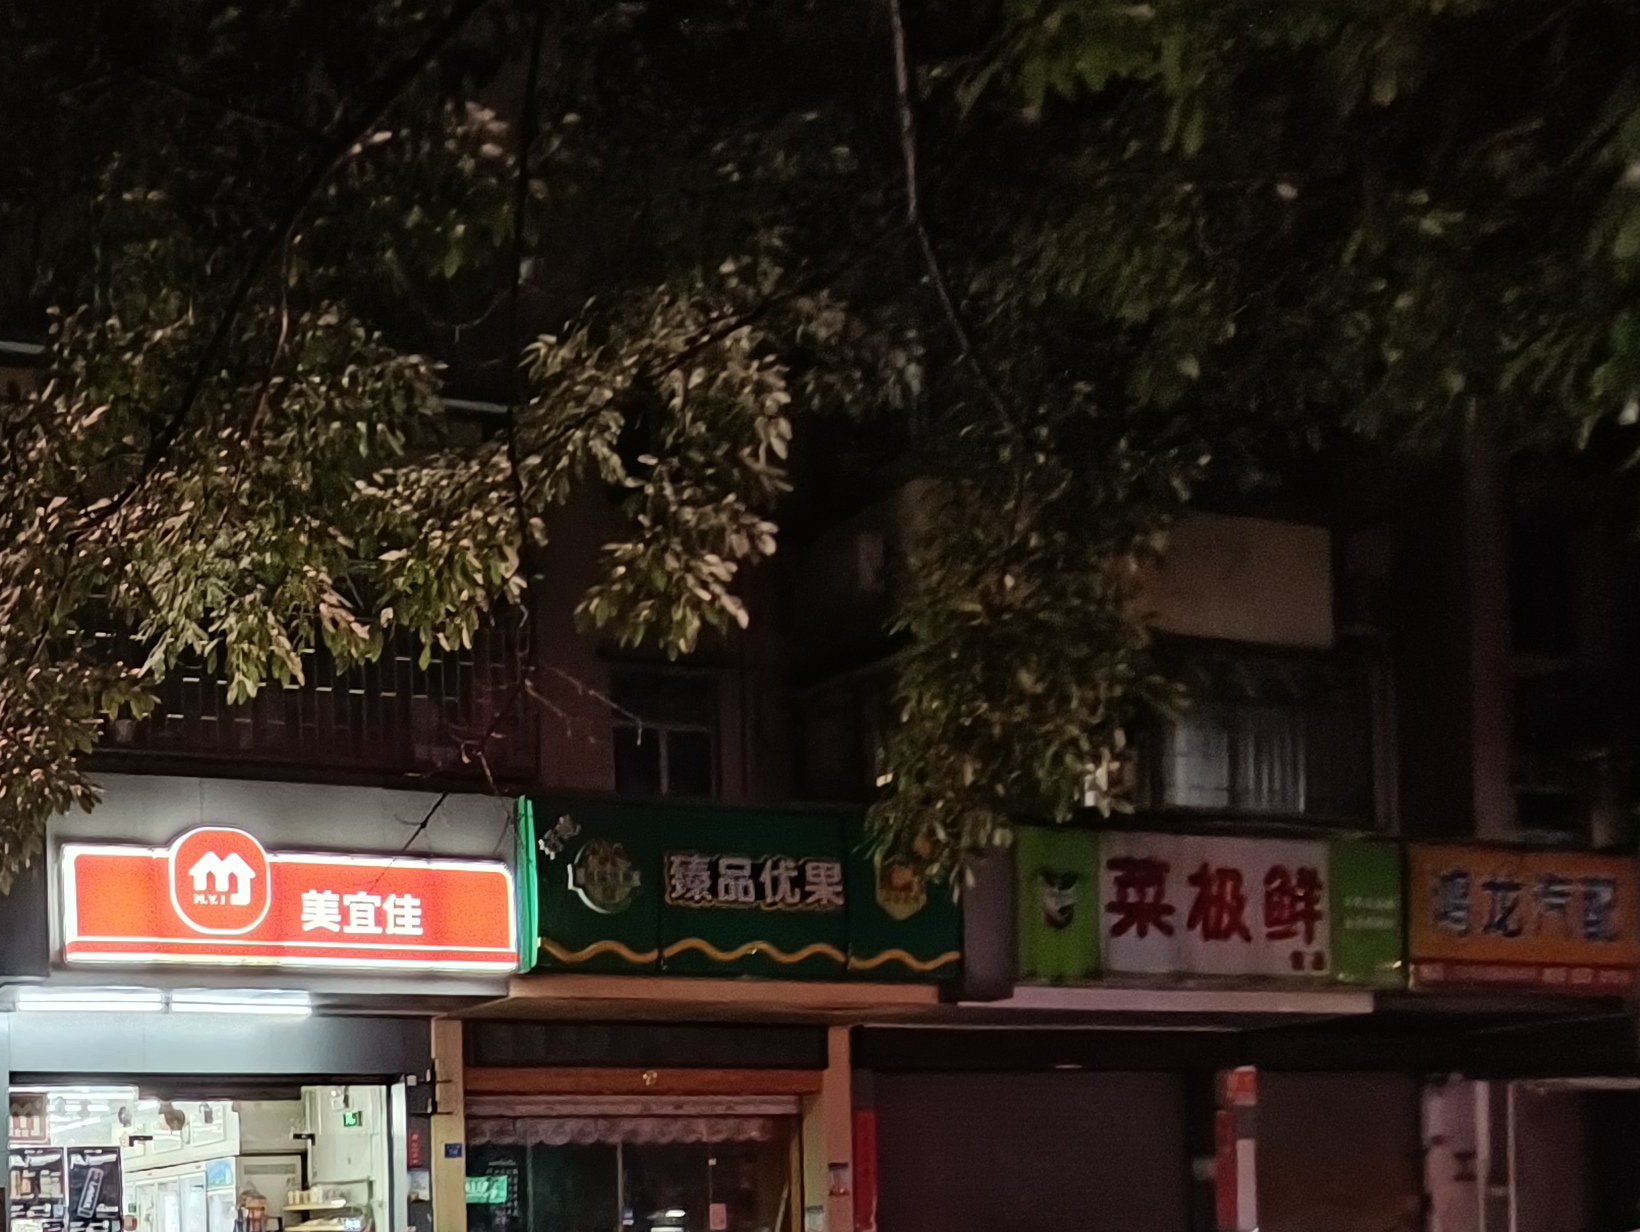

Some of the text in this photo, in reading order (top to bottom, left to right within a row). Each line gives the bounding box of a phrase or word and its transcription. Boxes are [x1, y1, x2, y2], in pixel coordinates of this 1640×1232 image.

[669, 853, 844, 905] 臻品优果
[1105, 855, 1323, 944] 菜极鲜
[300, 890, 424, 936] 美宜佳
